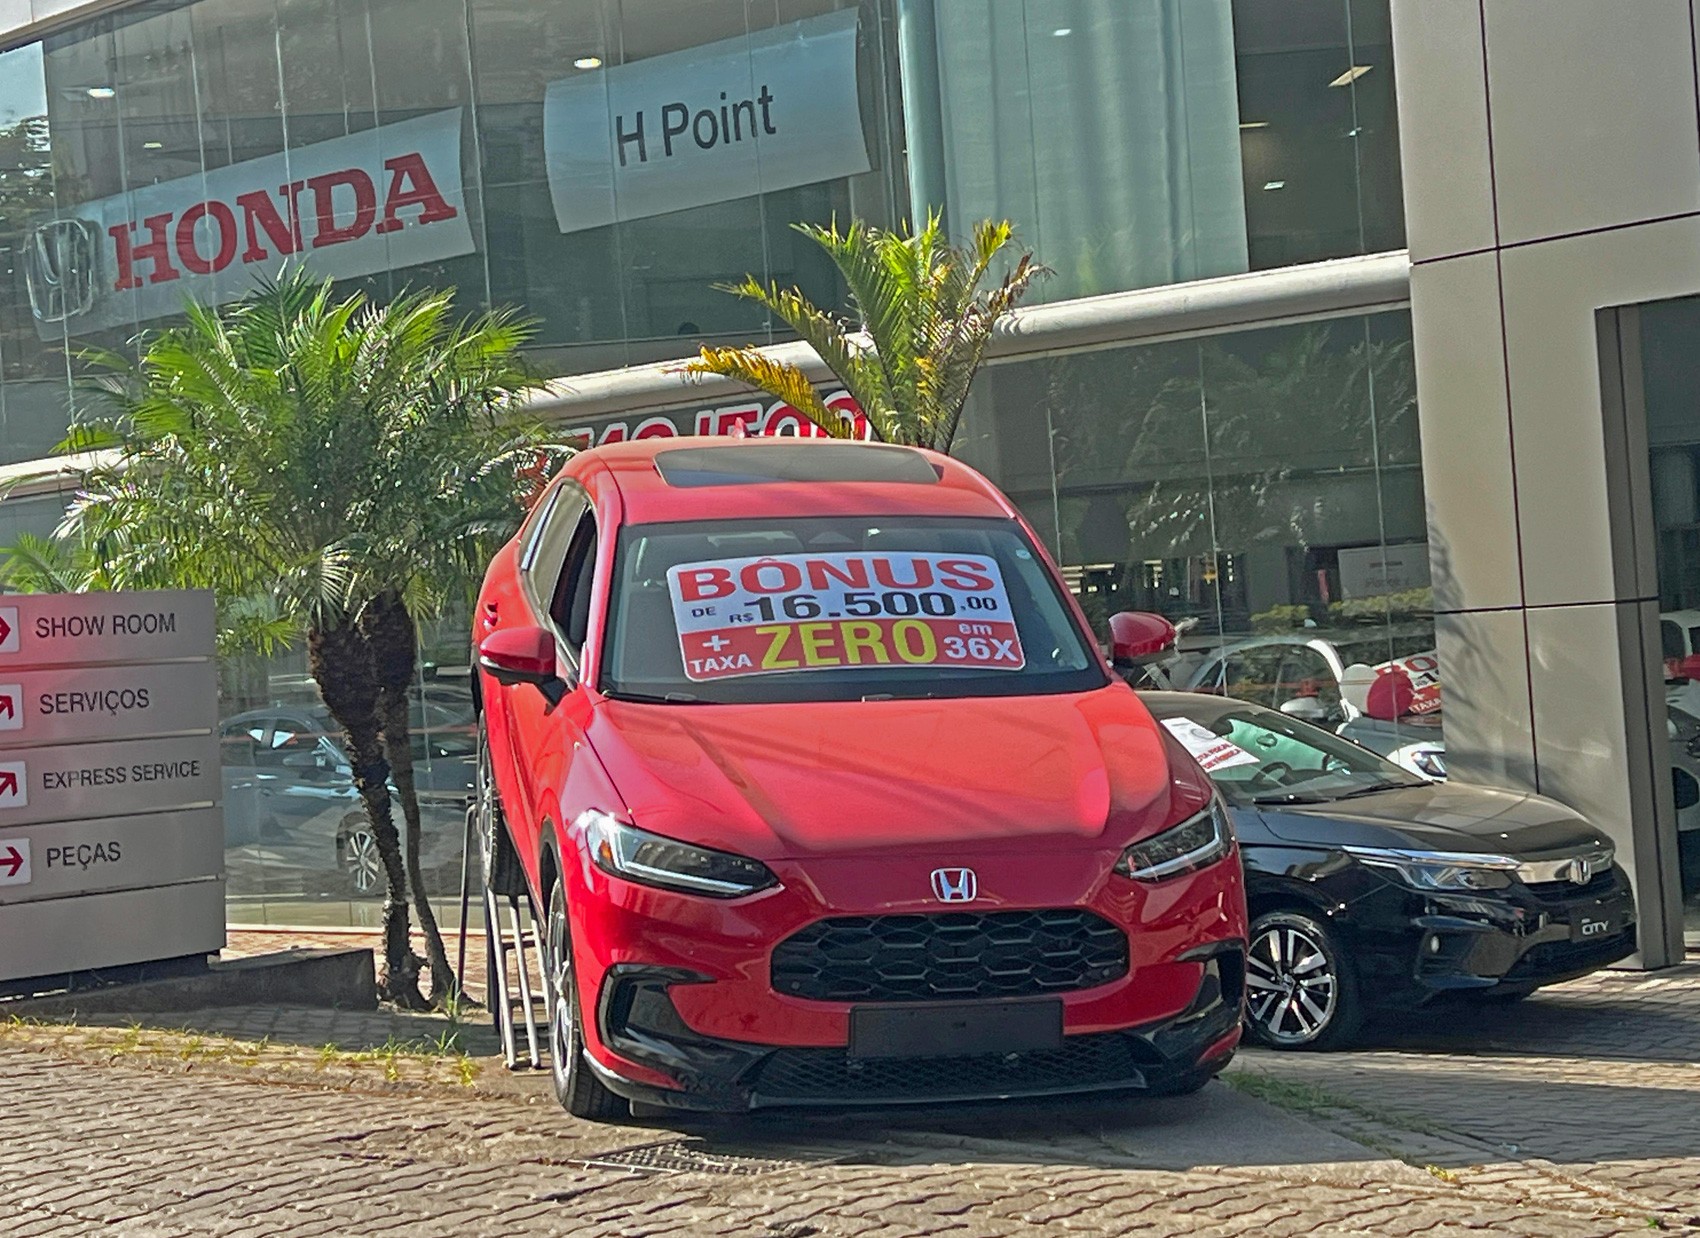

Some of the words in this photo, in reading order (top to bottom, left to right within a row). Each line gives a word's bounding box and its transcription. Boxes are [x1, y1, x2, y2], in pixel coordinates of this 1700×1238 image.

[616, 111, 648, 167] H
[662, 85, 777, 157] Point
[108, 152, 458, 292] HONDA
[677, 557, 996, 602] BÔNUS
[35, 614, 105, 639] SHOW
[112, 612, 177, 635] ROOM
[691, 606, 717, 618] DE
[957, 622, 993, 636] em
[688, 653, 754, 673] TAXA
[755, 619, 938, 671] ZERO
[943, 636, 1020, 662] 36X
[39, 688, 150, 716] SERVIÇOS
[43, 766, 127, 790] EXPRESS
[132, 760, 201, 782] SERVICE
[46, 841, 122, 871] PEÇAS
